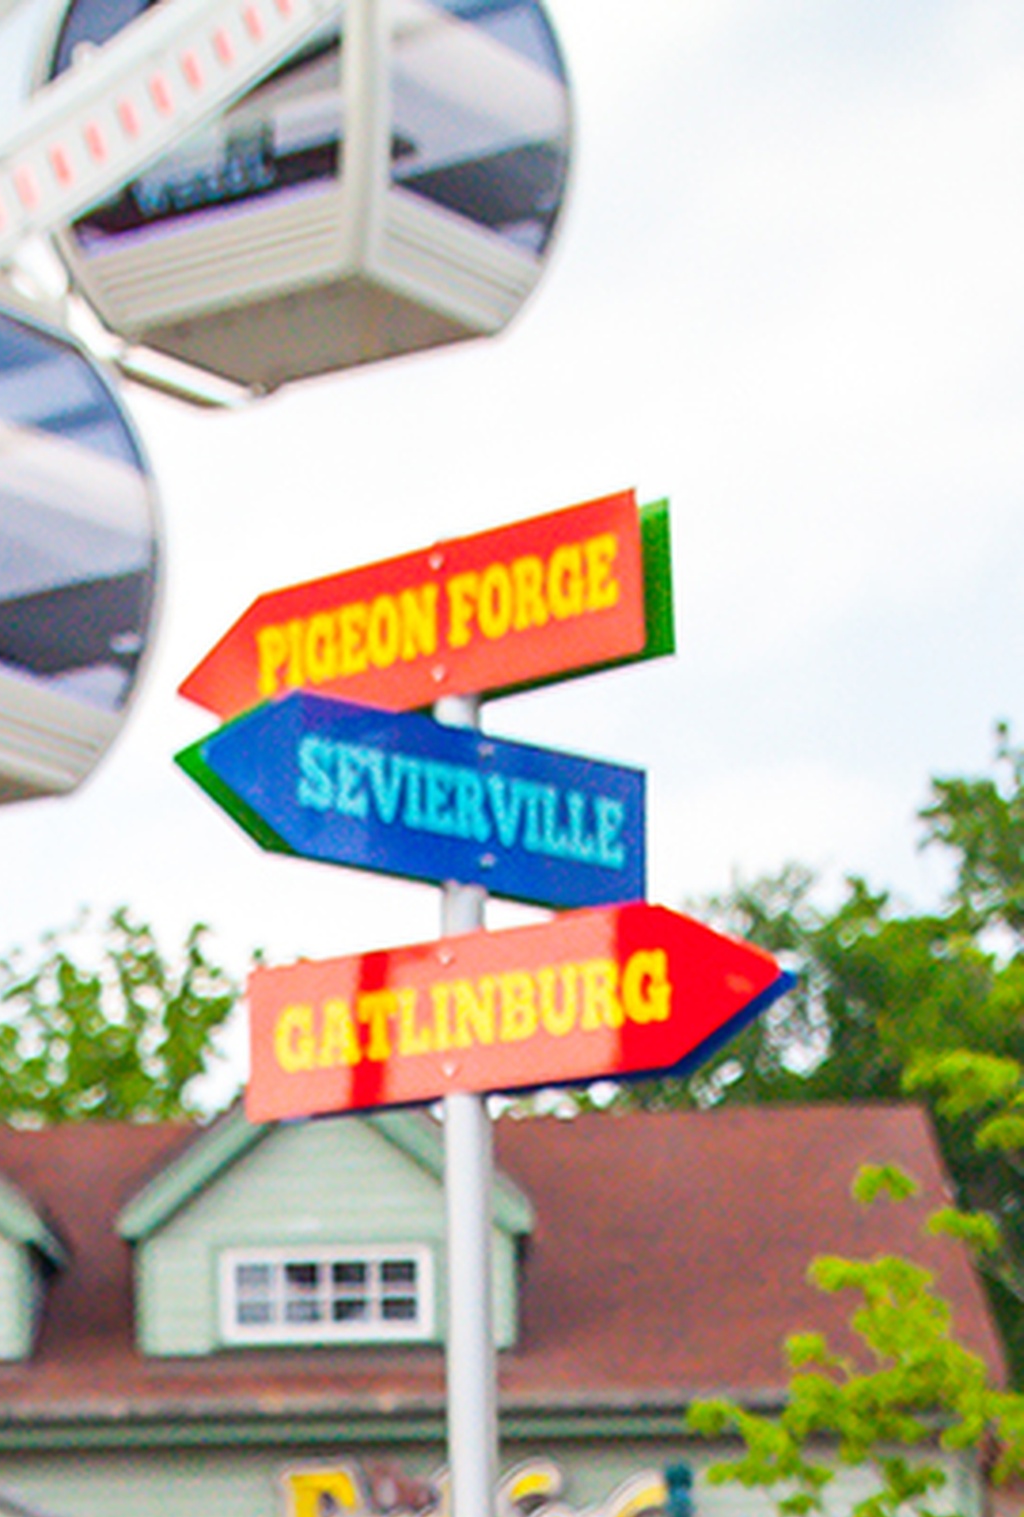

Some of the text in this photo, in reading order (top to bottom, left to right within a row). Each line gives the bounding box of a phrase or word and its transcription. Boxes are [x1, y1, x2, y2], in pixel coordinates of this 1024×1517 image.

[258, 534, 619, 696] PIGEON FORGE
[296, 734, 626, 870] SEVIERVILLE
[274, 950, 671, 1074] GATLINBURG
